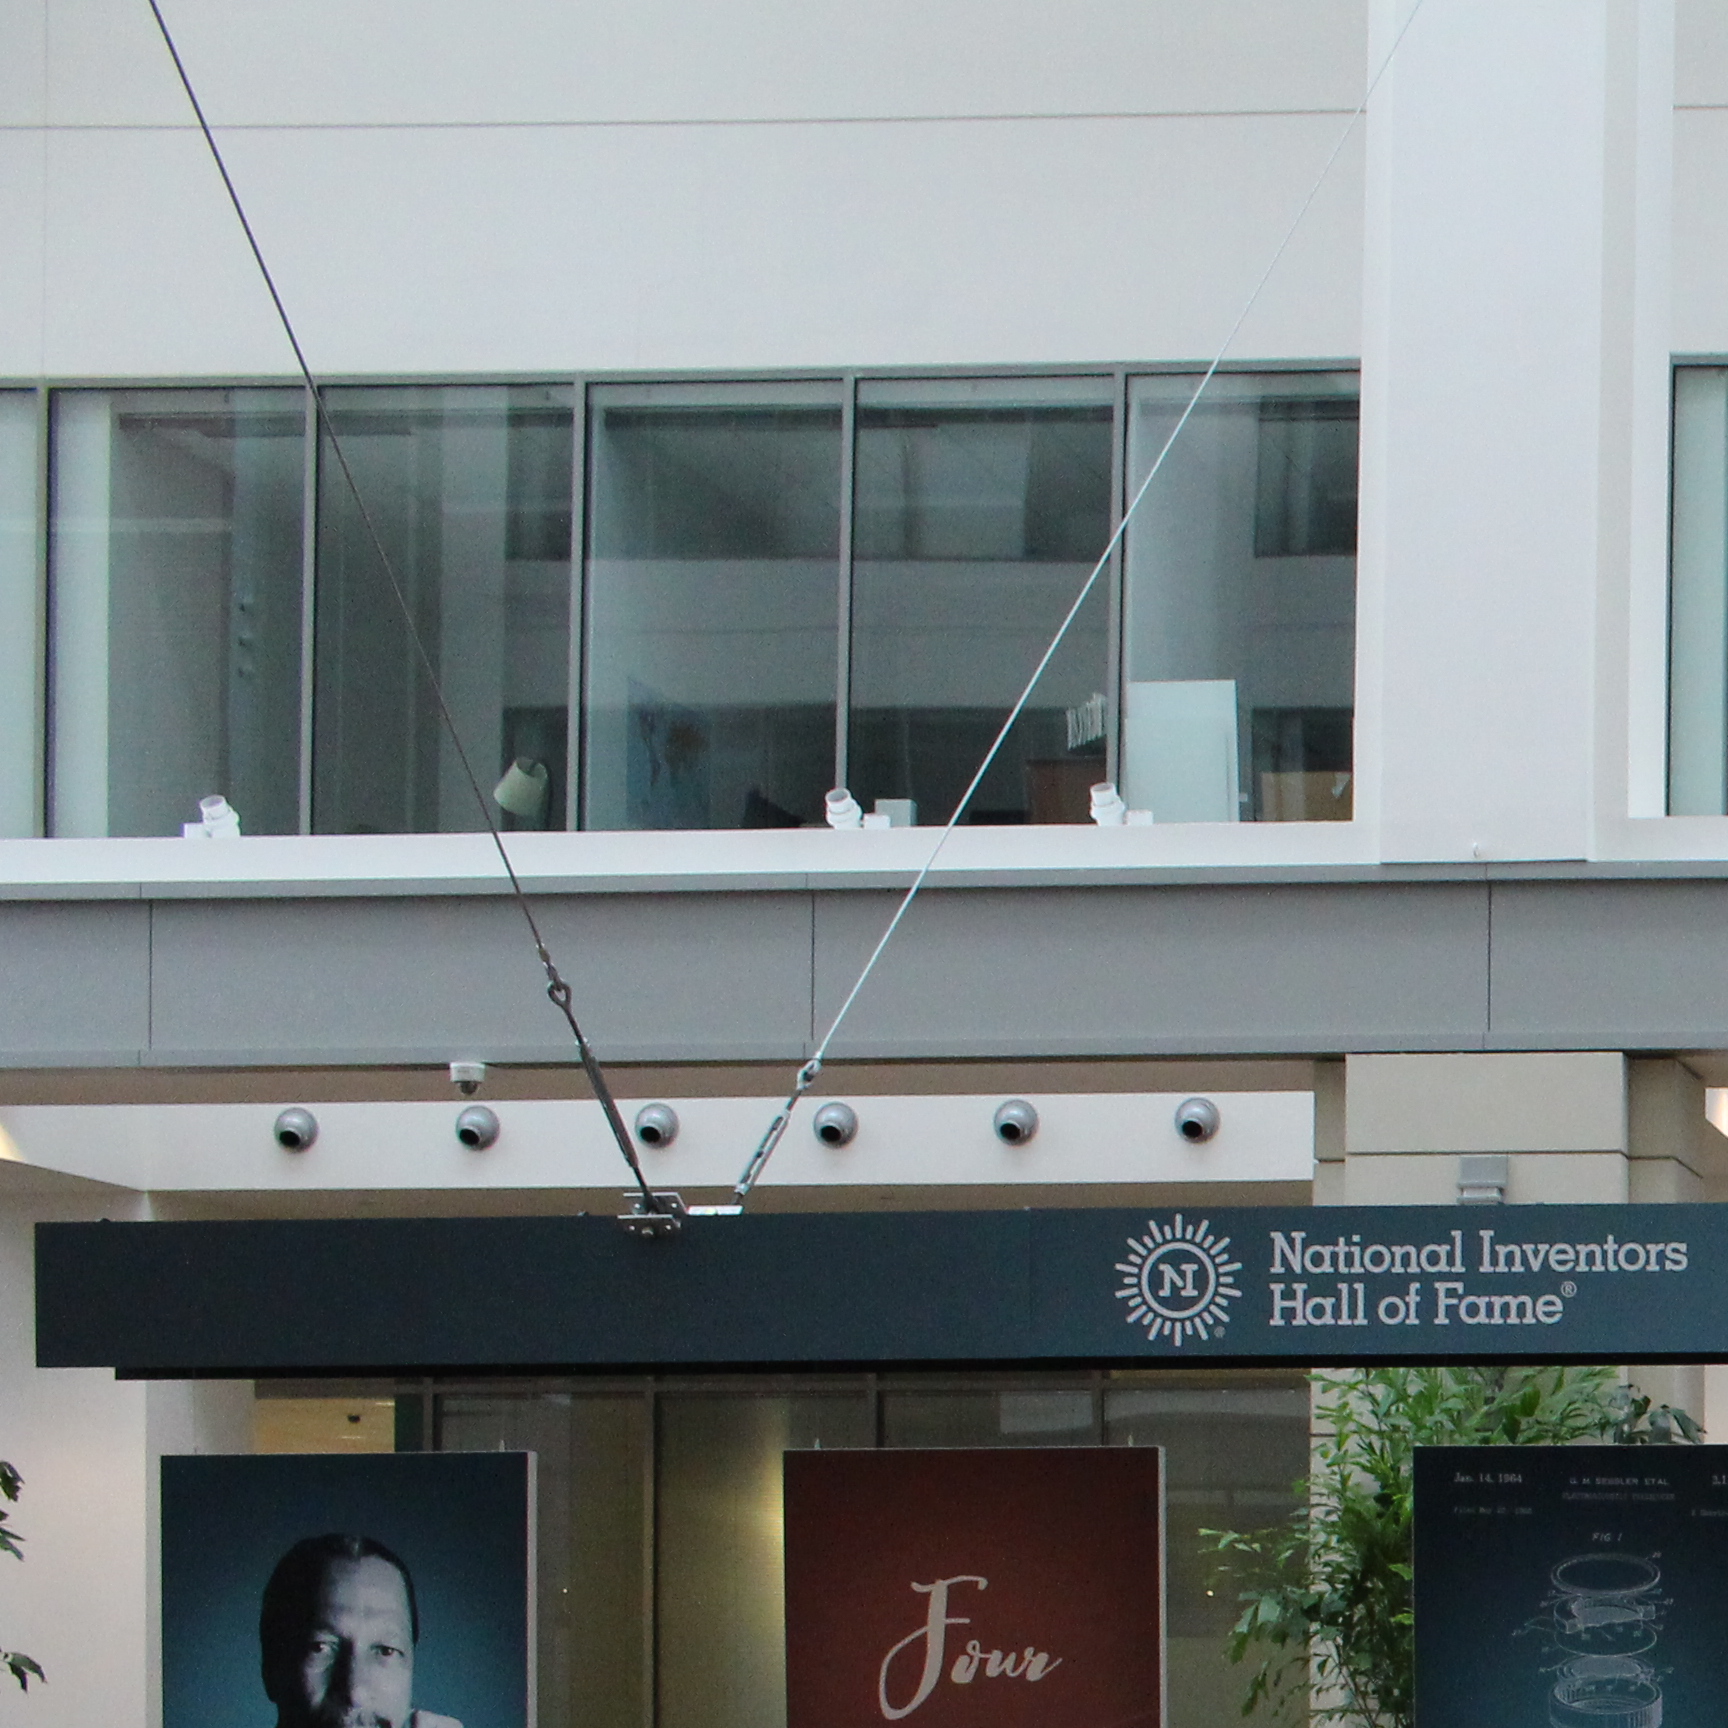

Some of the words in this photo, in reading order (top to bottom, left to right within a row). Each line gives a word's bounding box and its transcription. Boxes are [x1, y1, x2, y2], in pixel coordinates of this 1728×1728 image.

[1269, 1230, 1465, 1274] National
[1480, 1229, 1689, 1274] Inventors
[1269, 1282, 1369, 1327] Hall
[1378, 1283, 1429, 1326] of
[879, 1575, 1063, 1720] Four
